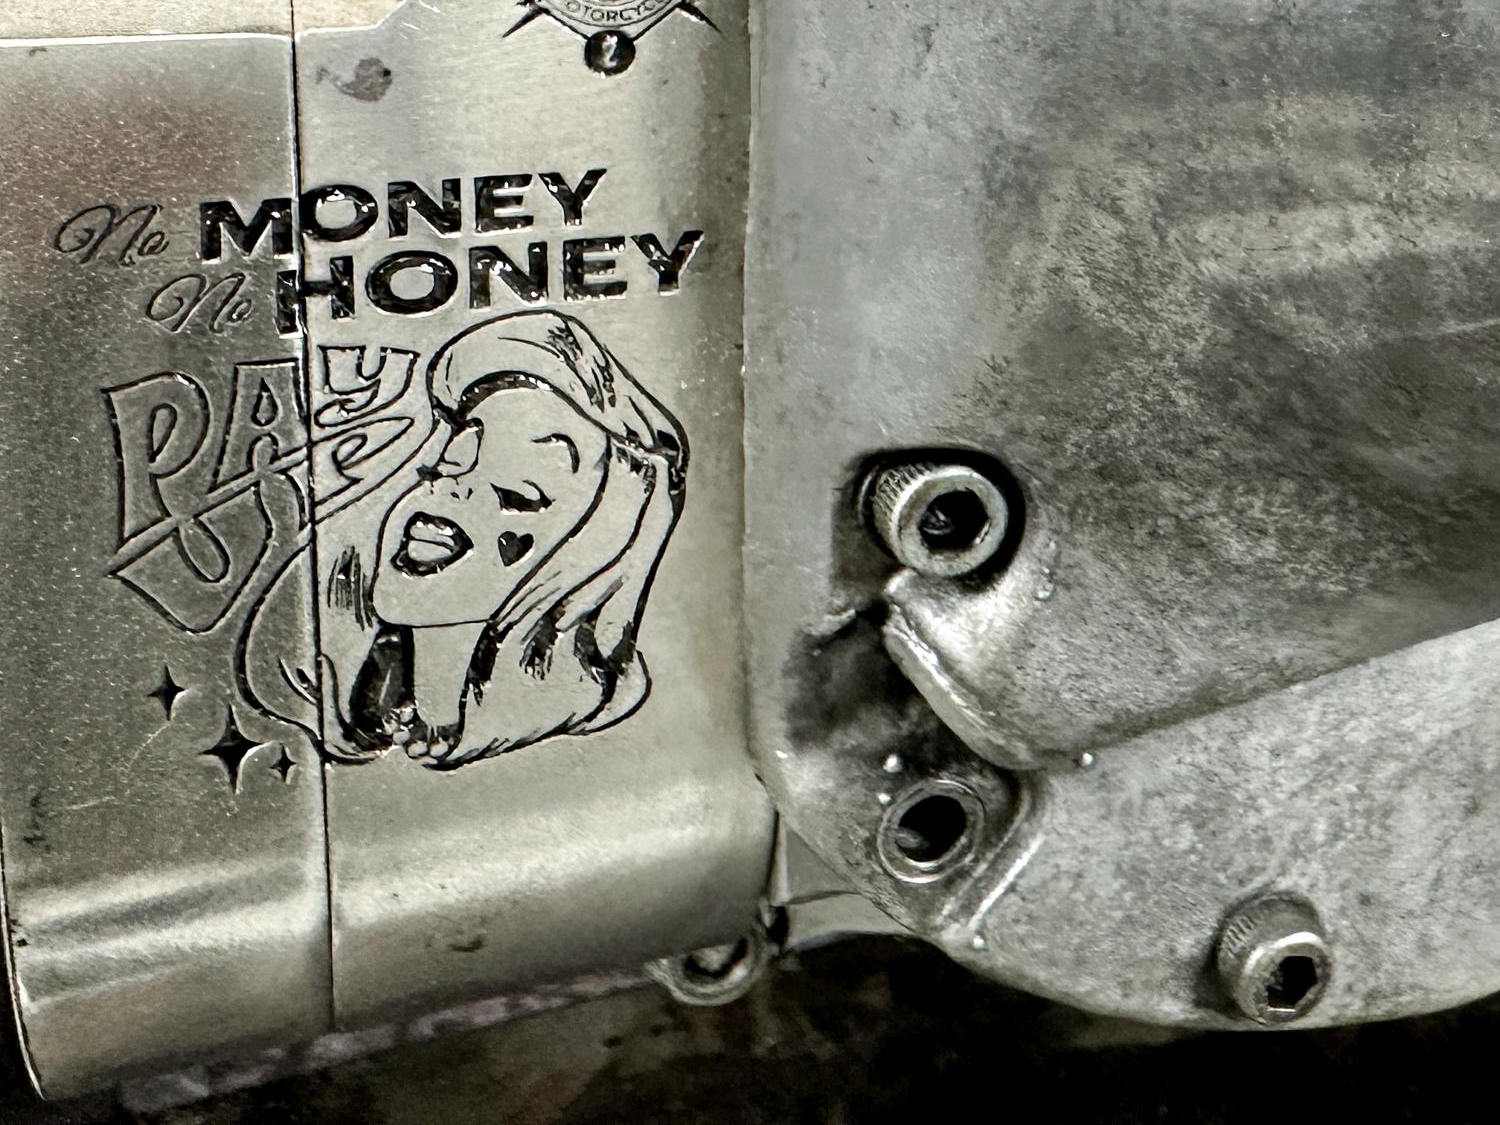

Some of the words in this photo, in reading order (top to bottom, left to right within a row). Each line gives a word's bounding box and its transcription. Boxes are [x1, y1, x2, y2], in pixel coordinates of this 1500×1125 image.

[54, 203, 170, 268] No
[199, 169, 608, 263] MONEY
[145, 273, 251, 333] No
[273, 231, 705, 338] HONEY
